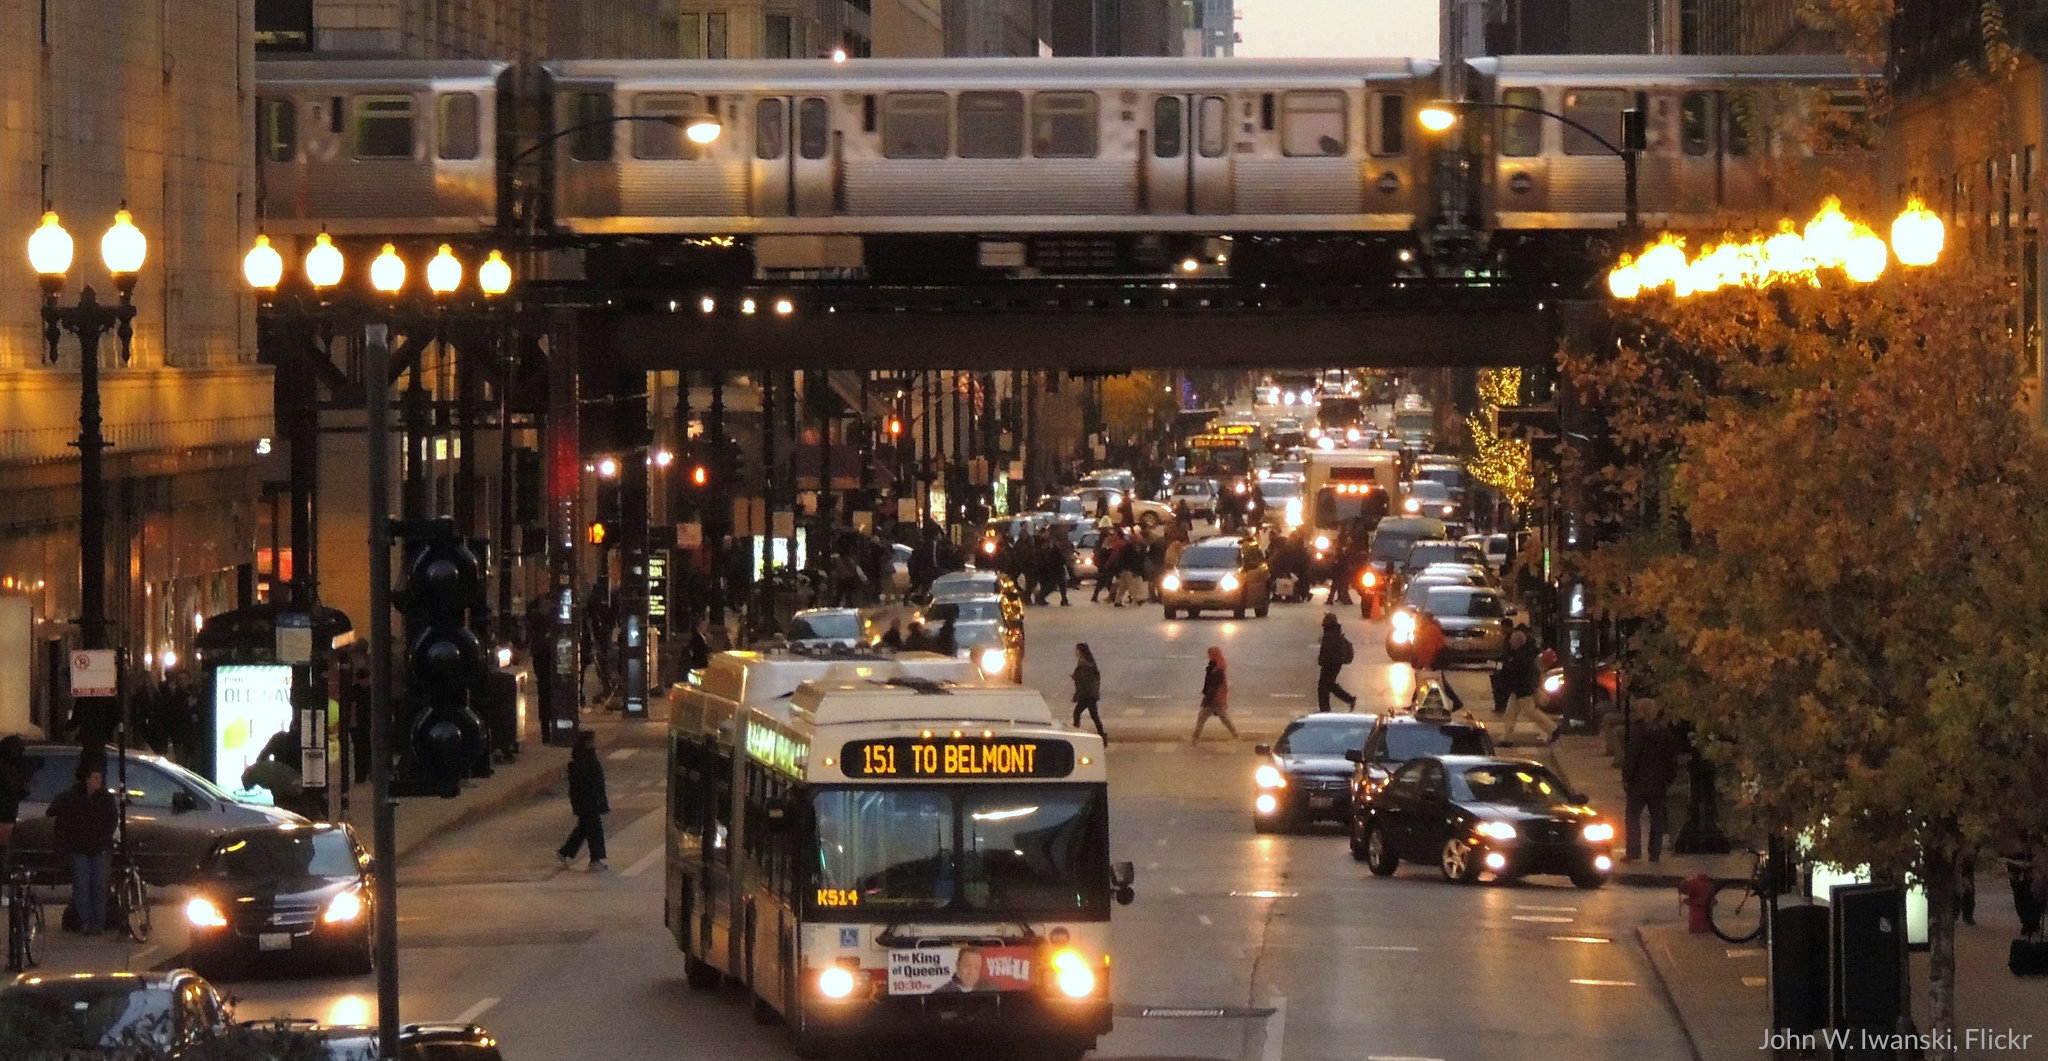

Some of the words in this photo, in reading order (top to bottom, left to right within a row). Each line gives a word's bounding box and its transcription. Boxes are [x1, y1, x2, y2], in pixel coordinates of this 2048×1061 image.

[863, 744, 896, 773] 151
[912, 744, 937, 773] TO
[944, 744, 1037, 773] BELMONT
[817, 888, 858, 906] K514
[892, 953, 909, 963] The
[911, 953, 941, 965] King
[892, 966, 904, 975] of
[904, 965, 950, 978] Queens
